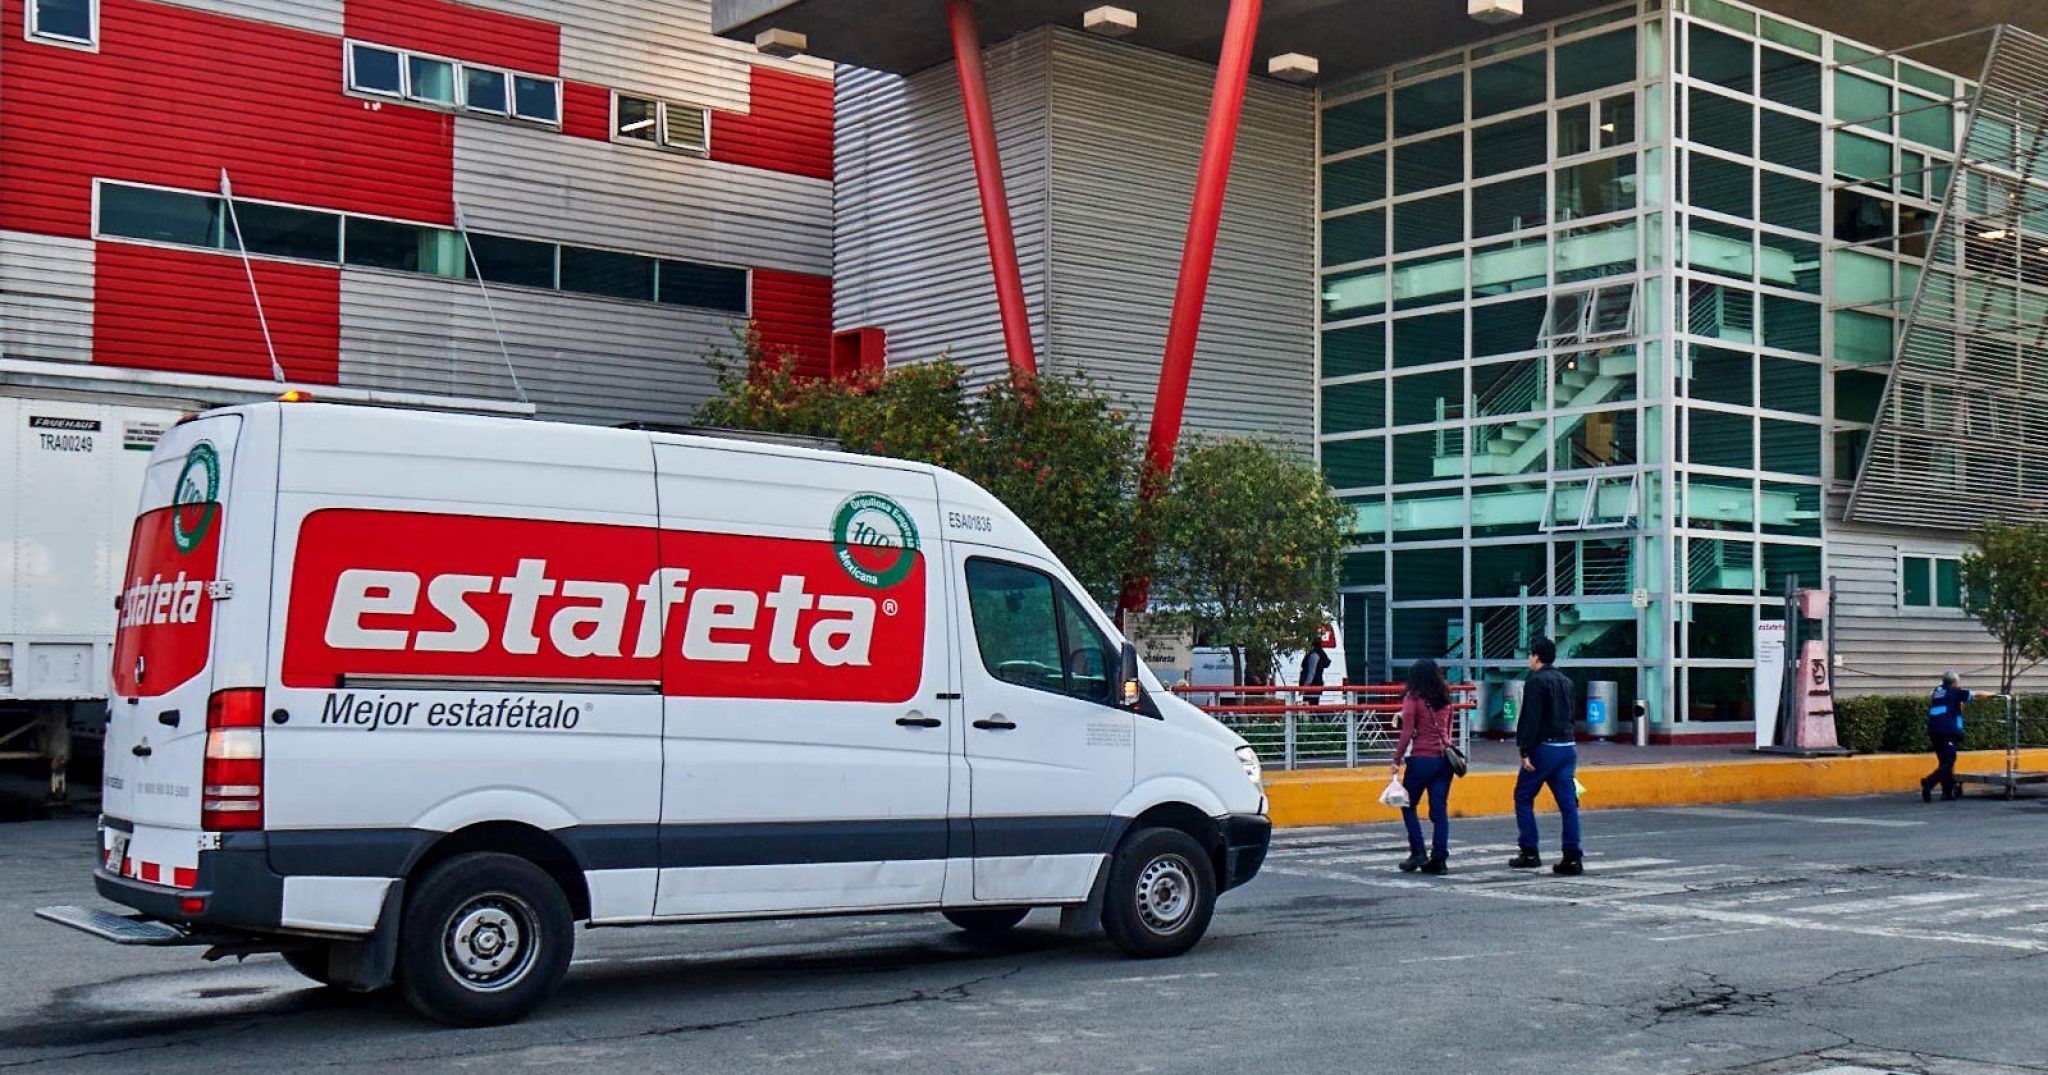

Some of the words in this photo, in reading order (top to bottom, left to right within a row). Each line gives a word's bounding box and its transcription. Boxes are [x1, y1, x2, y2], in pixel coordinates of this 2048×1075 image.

[35, 418, 97, 430] FRUEHAUF
[39, 433, 94, 453] TRA00249
[850, 497, 892, 513] Orgullosa
[891, 508, 915, 548] Empresa
[838, 549, 878, 585] Mexicana
[321, 693, 420, 731] Mejor
